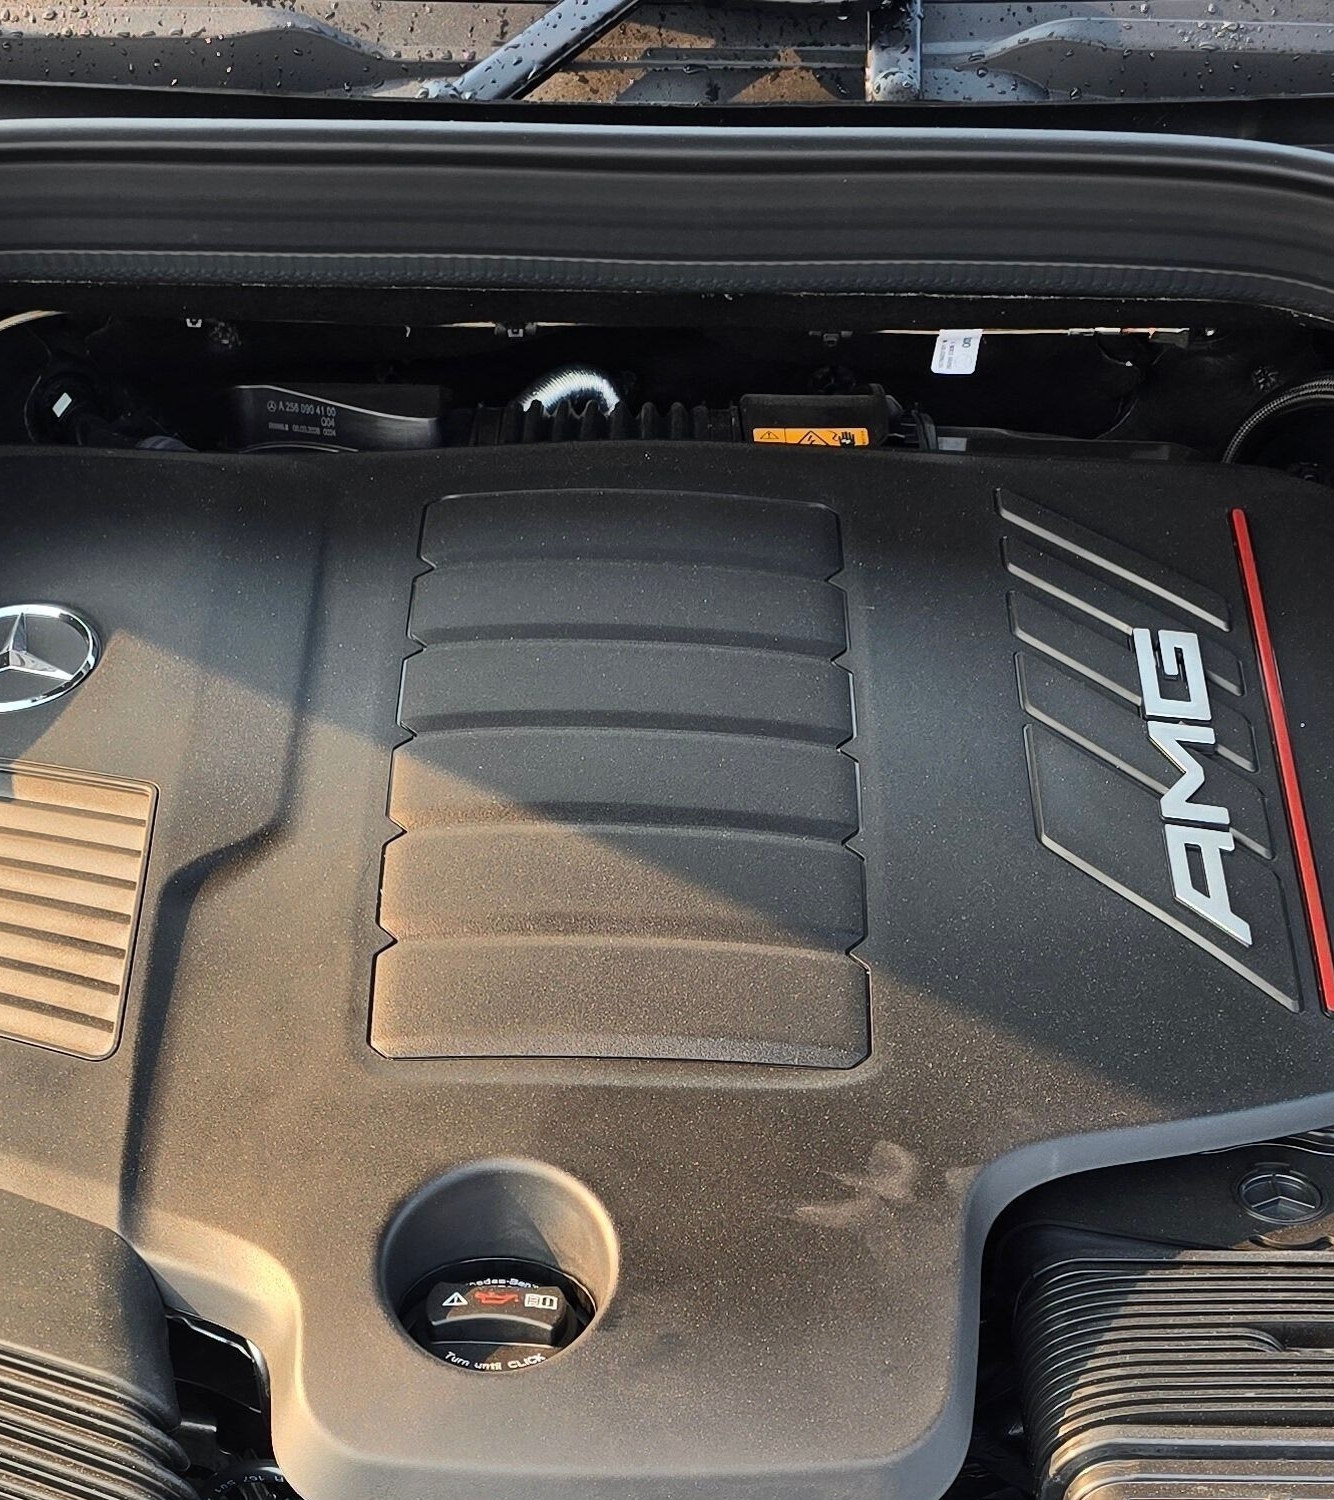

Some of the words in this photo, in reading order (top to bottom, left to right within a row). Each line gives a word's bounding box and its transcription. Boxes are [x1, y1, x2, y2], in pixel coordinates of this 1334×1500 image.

[279, 401, 284, 411] A
[316, 406, 324, 416] 41
[327, 407, 336, 416] 00
[1132, 628, 1252, 946] AMG
[445, 1351, 470, 1367] Turn
[474, 1361, 503, 1371] until
[507, 1353, 546, 1369] CLICK
